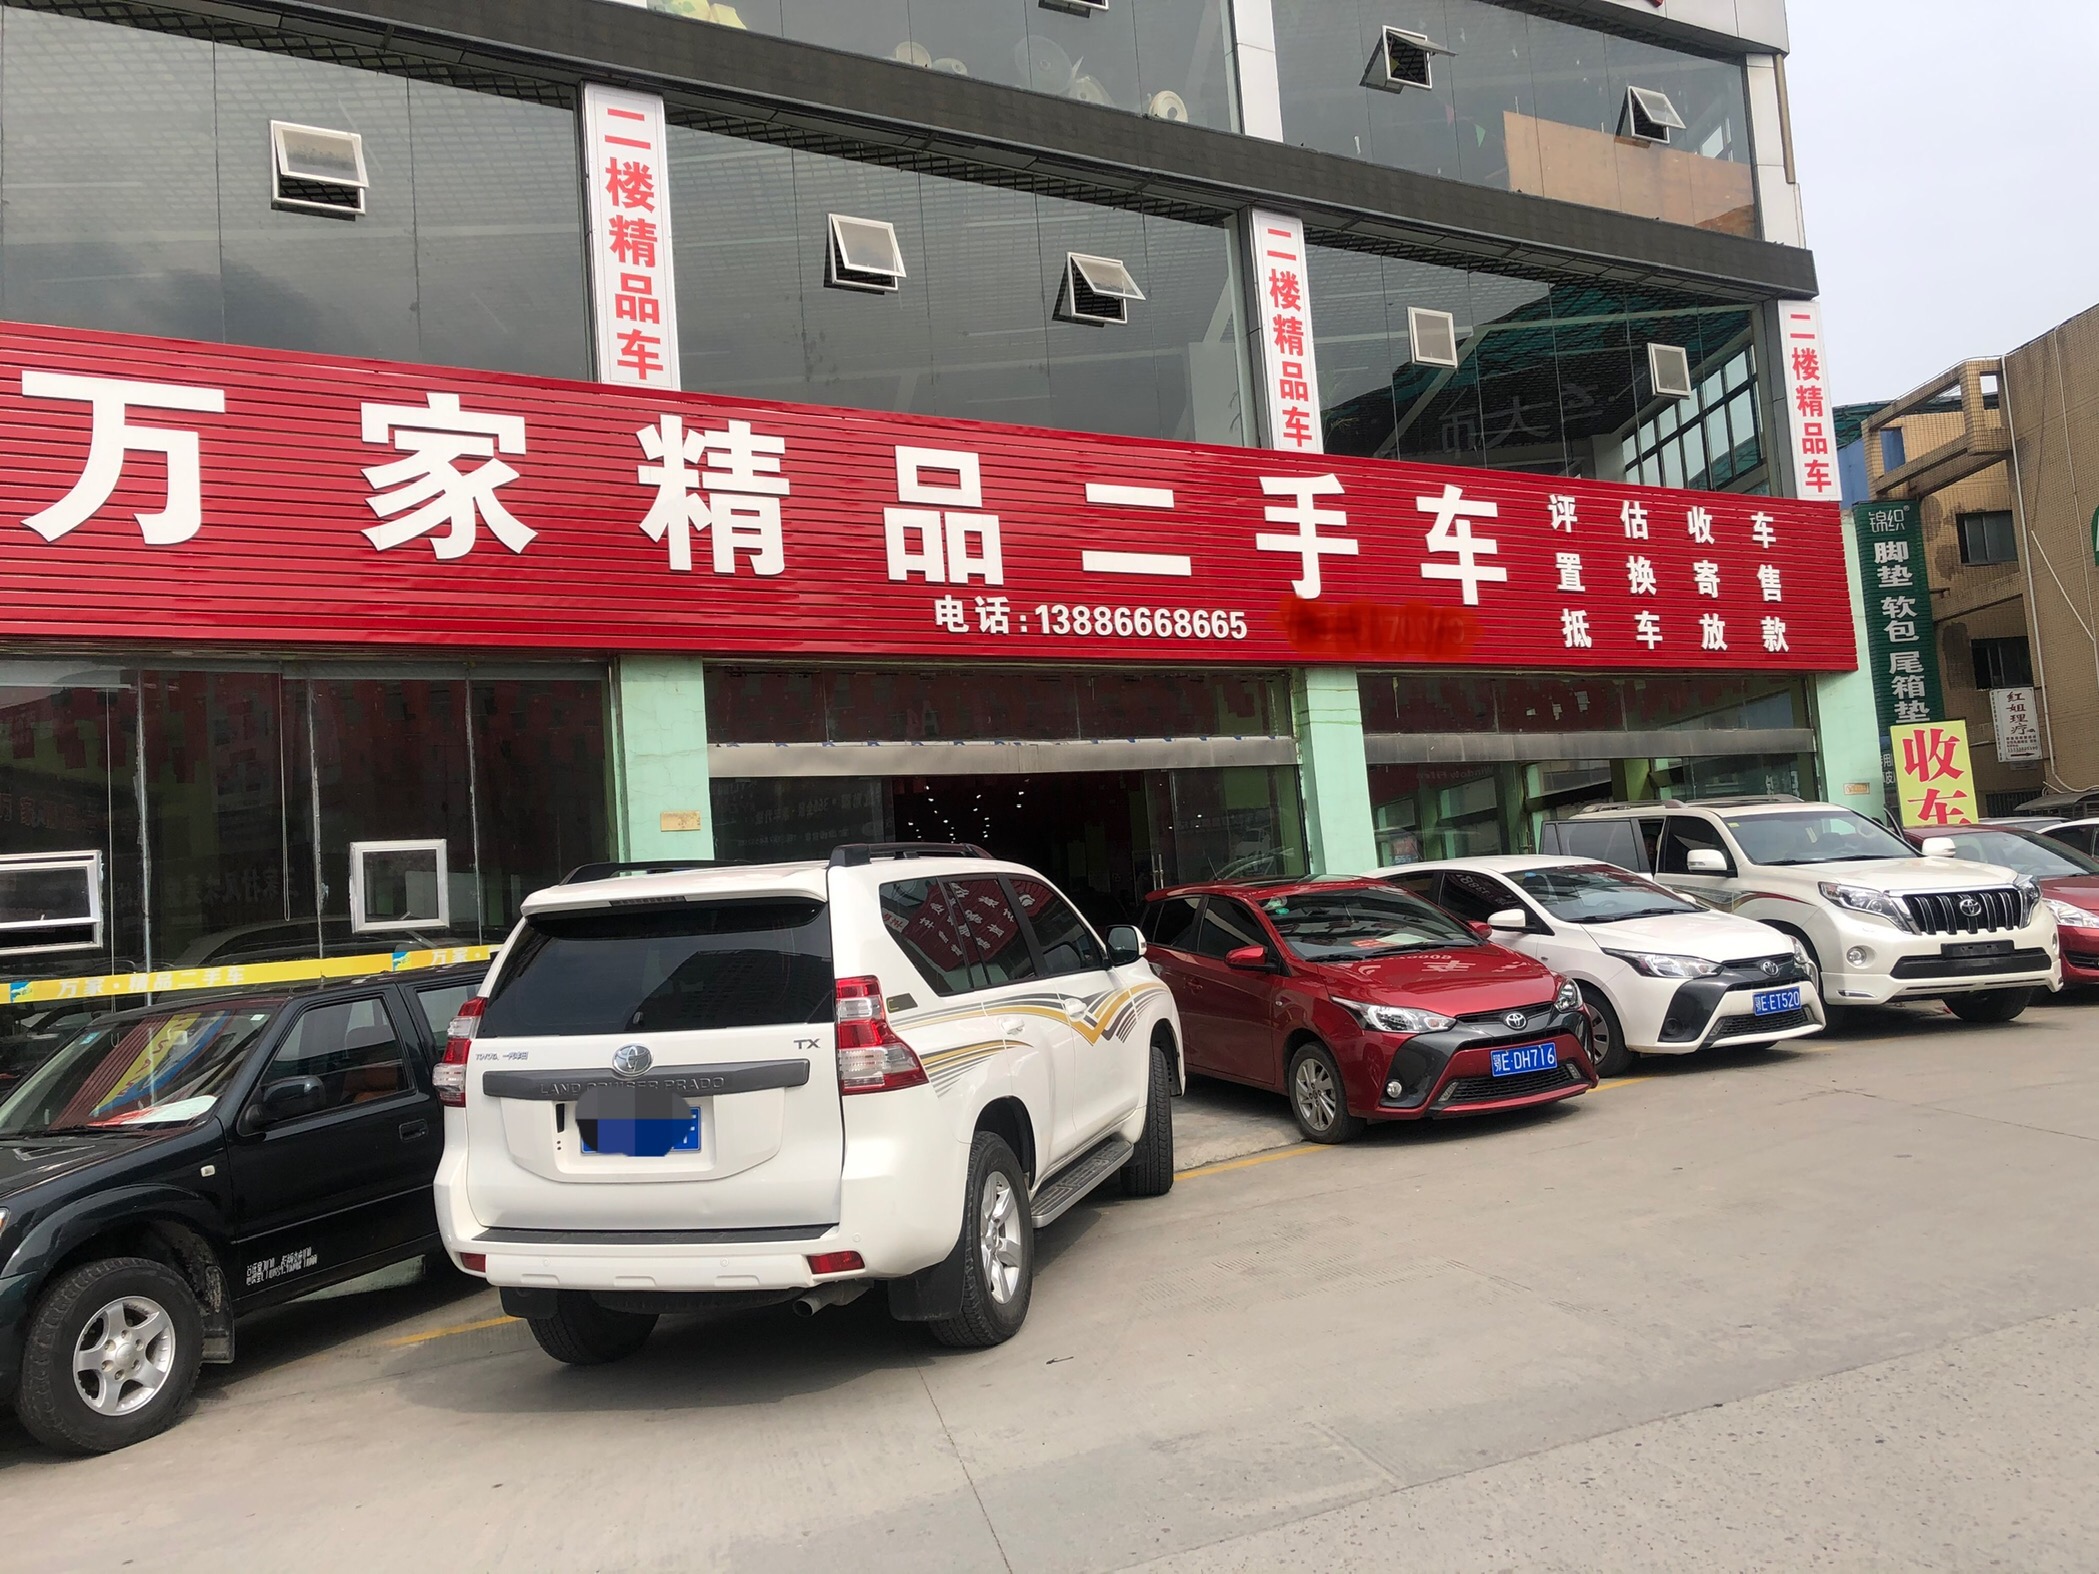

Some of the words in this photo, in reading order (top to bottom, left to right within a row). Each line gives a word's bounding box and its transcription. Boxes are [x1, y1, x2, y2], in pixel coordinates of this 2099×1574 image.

[605, 108, 664, 381] 二楼精品车
[1266, 228, 1313, 448] 二楼精品车
[1790, 313, 1833, 493] 二楼精品车
[21, 369, 1509, 606] 万家精品二手车
[1547, 493, 1778, 549] 评估收车
[1868, 508, 1906, 532] 锦织
[1555, 551, 1783, 602] 置换寄售
[1874, 541, 1914, 588] 脚垫
[1560, 608, 1791, 653] 抵车放款
[1881, 596, 1920, 643] 软包
[1889, 651, 1931, 724] 尾箱垫
[2005, 691, 2029, 735] 红姐理疗
[1901, 727, 1971, 825] 收车
[793, 1037, 821, 1050] TX
[540, 1083, 582, 1096] LAND
[663, 1076, 726, 1091] PRADO
